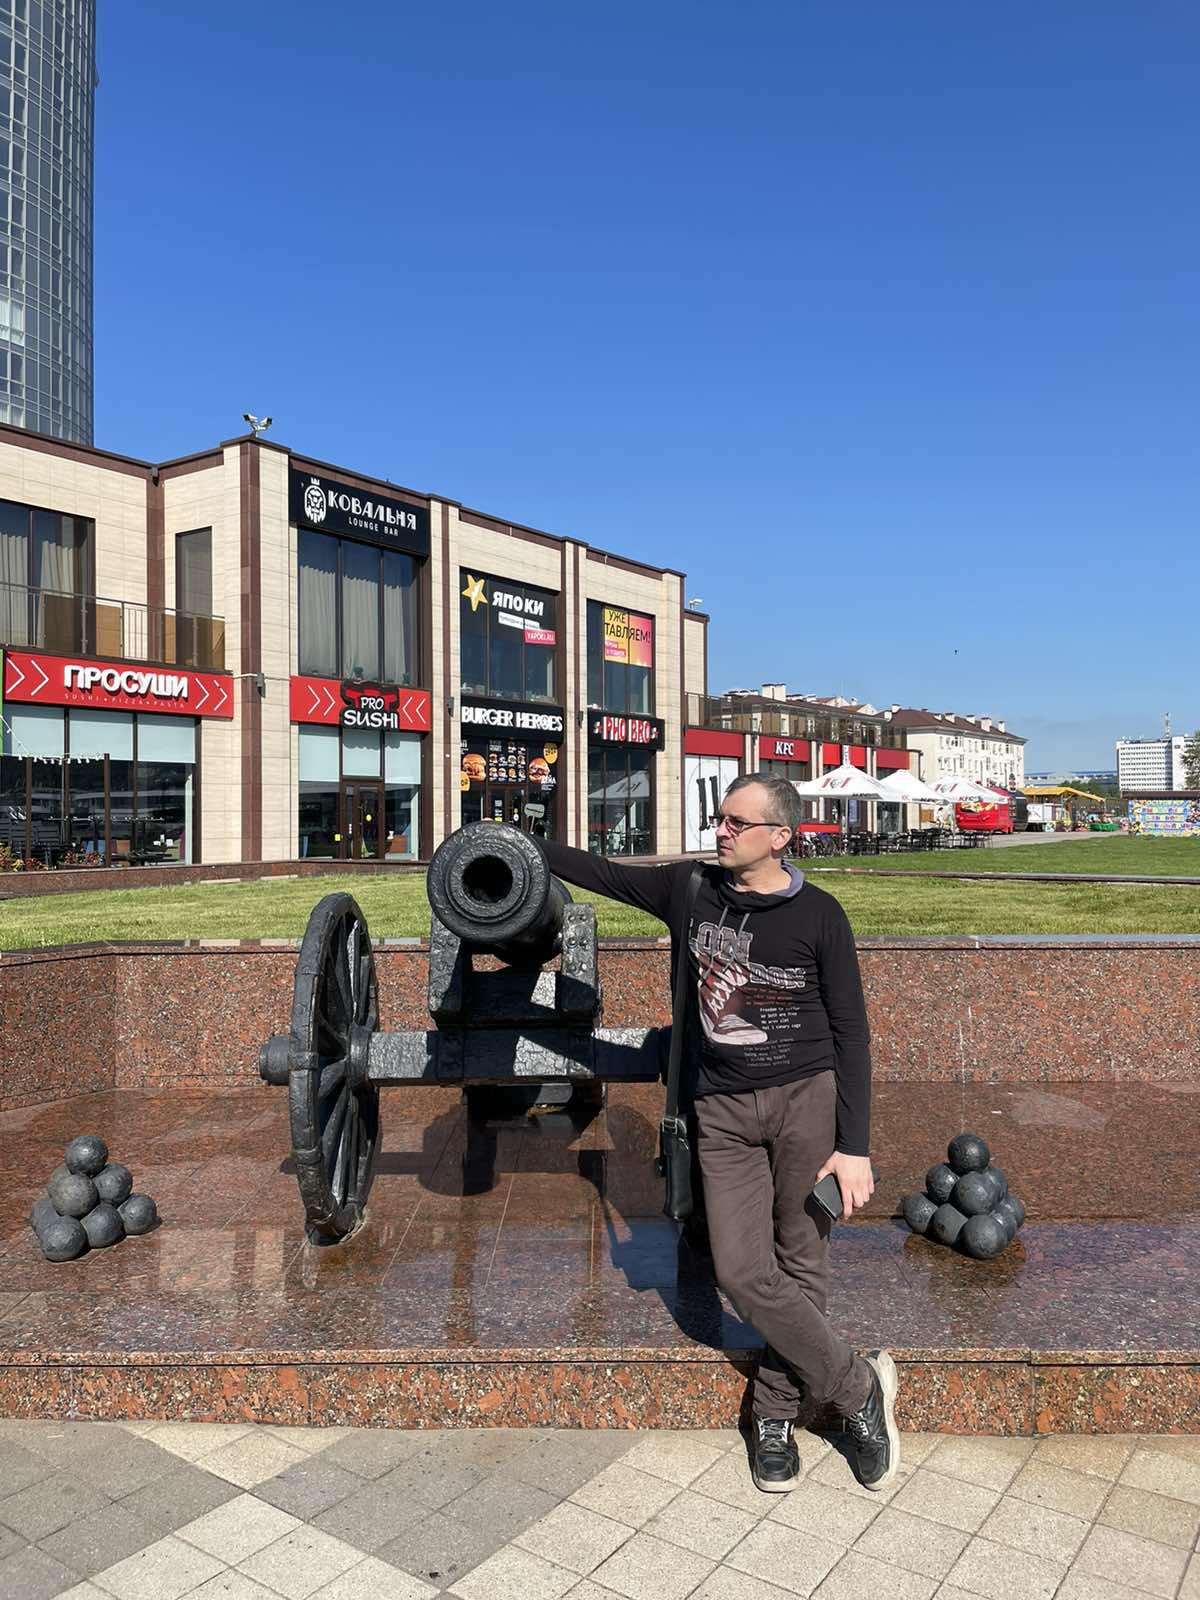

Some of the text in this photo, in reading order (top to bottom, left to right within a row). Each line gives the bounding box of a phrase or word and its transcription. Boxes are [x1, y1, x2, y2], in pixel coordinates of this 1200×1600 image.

[328, 490, 417, 530] КОВАЛЬНЯ
[348, 517, 399, 537] LOUNGE BAR
[492, 591, 544, 617] ЯПОКИ
[608, 610, 626, 624] УЖЕ
[64, 664, 188, 699] ПРОСУШИ
[65, 693, 185, 709] SUSHI PIZZA PASTA
[360, 696, 384, 710] PRO
[344, 709, 398, 729] SUSHI
[461, 706, 563, 732] BURGER HEROES
[603, 716, 651, 744] PHO BRO
[775, 741, 795, 756] KFC
